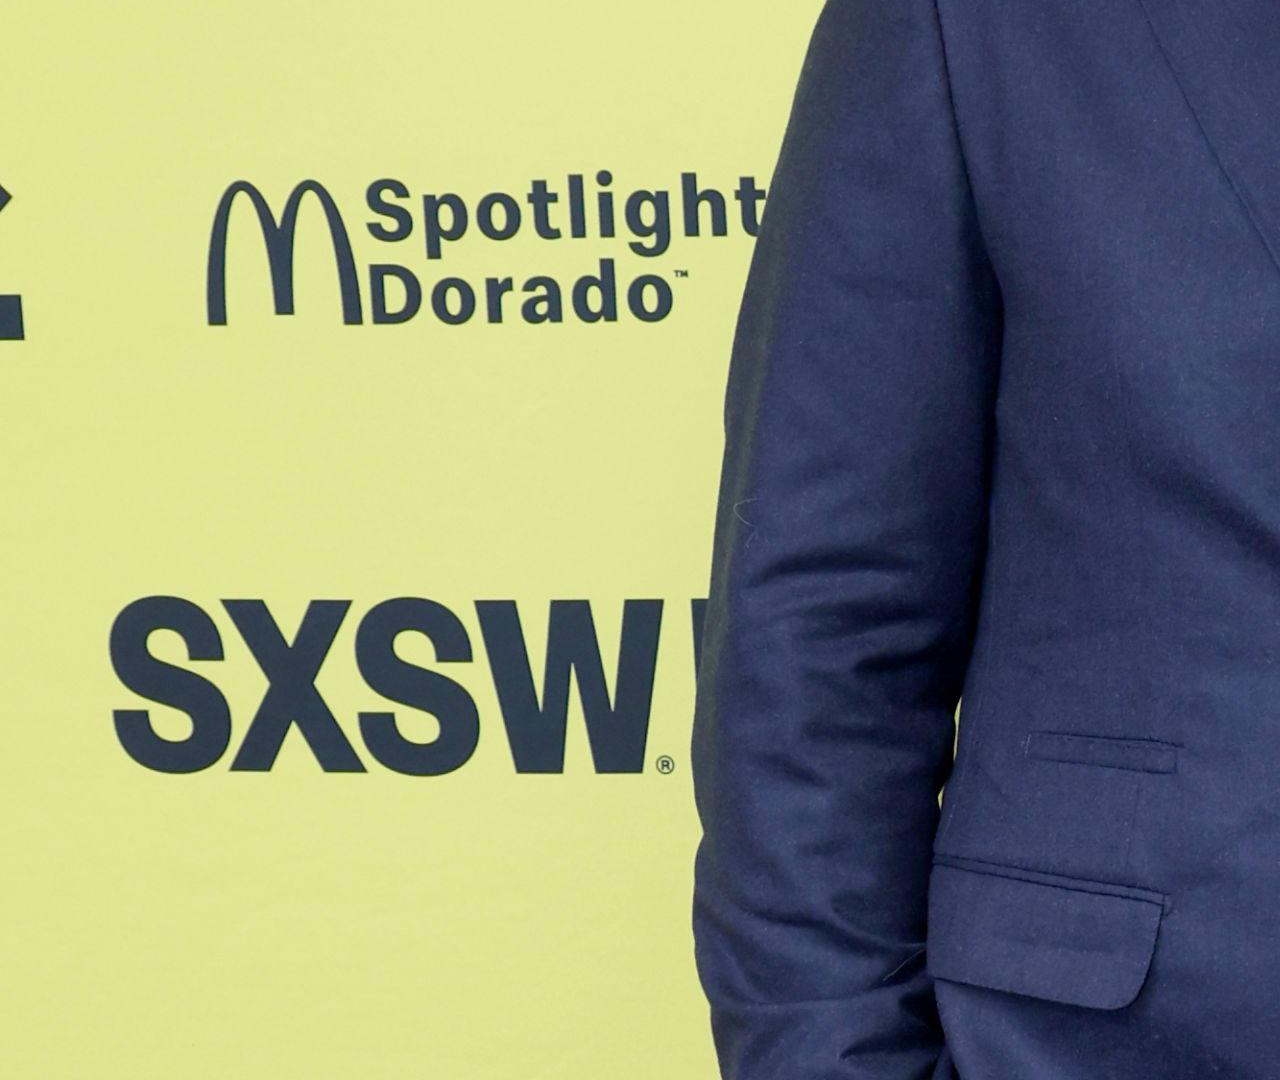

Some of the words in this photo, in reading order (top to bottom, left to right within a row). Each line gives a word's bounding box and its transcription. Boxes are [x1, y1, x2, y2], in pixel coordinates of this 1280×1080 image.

[365, 170, 768, 260] Spotlight
[369, 258, 674, 326] Dorado
[109, 595, 665, 777] SXSW
